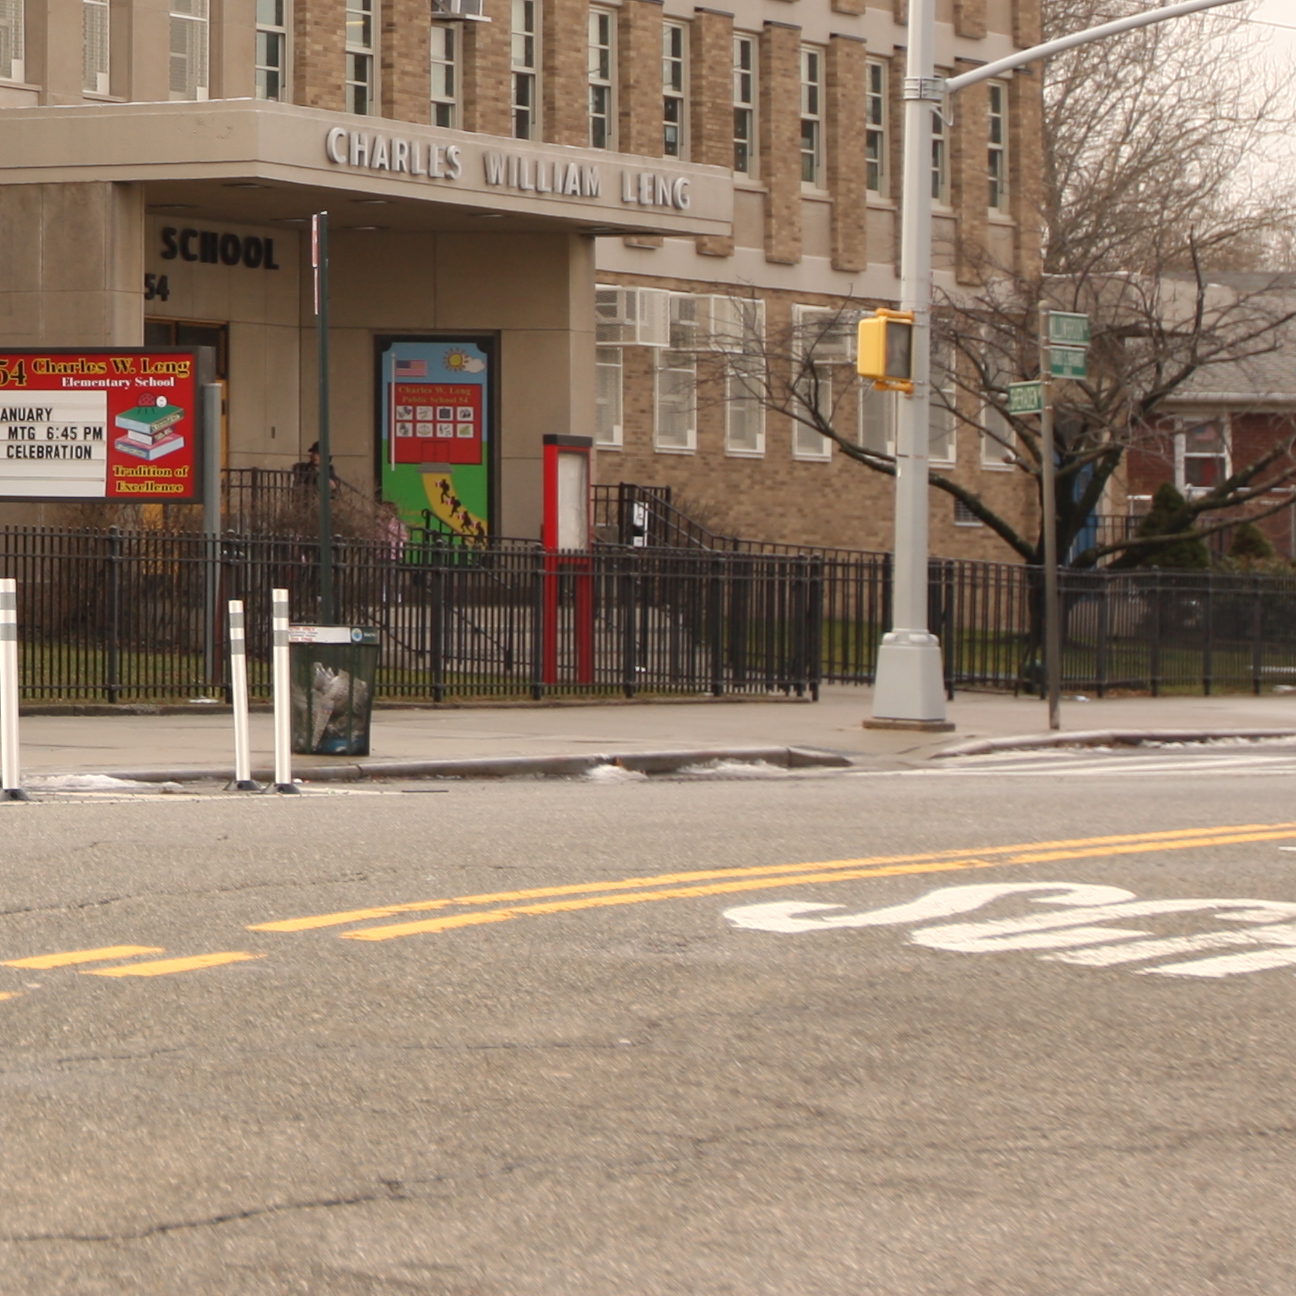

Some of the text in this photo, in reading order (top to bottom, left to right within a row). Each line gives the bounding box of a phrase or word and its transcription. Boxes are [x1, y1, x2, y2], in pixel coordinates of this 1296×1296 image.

[325, 127, 691, 210] CHARLES WILLIAM LENG
[160, 226, 280, 270] SCHOOL
[144, 273, 170, 301] 54
[32, 357, 191, 378] Charles W. Leng
[61, 376, 175, 390] Elementary School
[8, 426, 36, 440] MTG
[46, 426, 78, 440] 6:45
[83, 426, 103, 440] PM
[6, 444, 92, 459] CELEBRATION
[112, 465, 189, 477] Tradition of
[115, 480, 184, 493] Excellence
